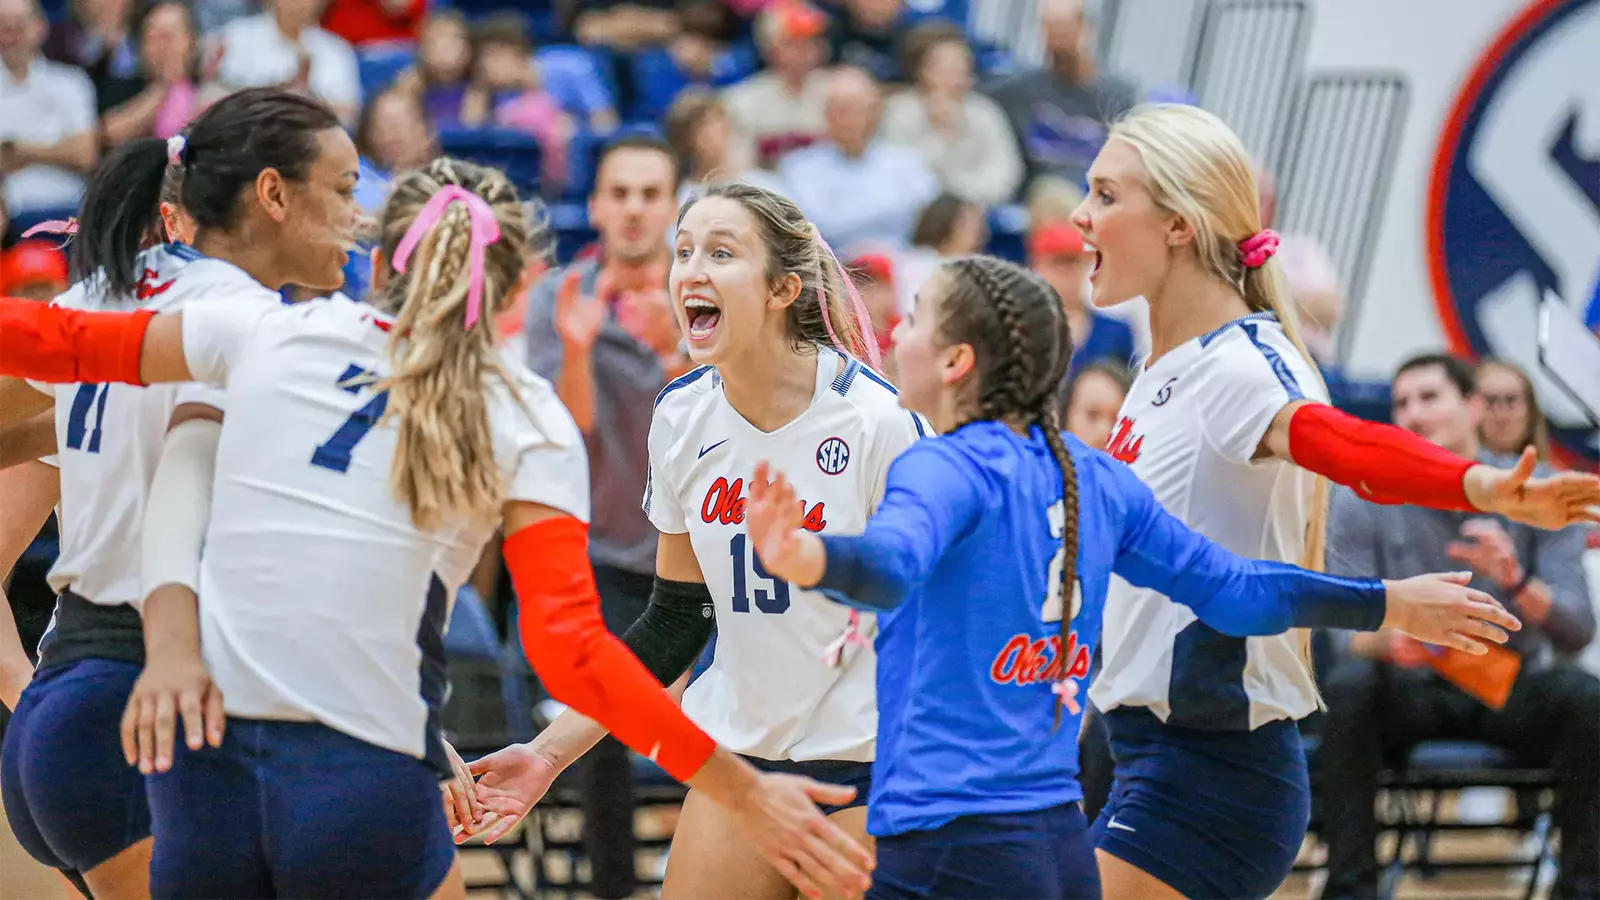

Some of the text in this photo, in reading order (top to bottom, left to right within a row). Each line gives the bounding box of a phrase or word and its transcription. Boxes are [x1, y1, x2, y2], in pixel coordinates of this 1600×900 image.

[310, 363, 390, 475] 7
[818, 438, 849, 473] SEC
[701, 476, 748, 525] Ole
